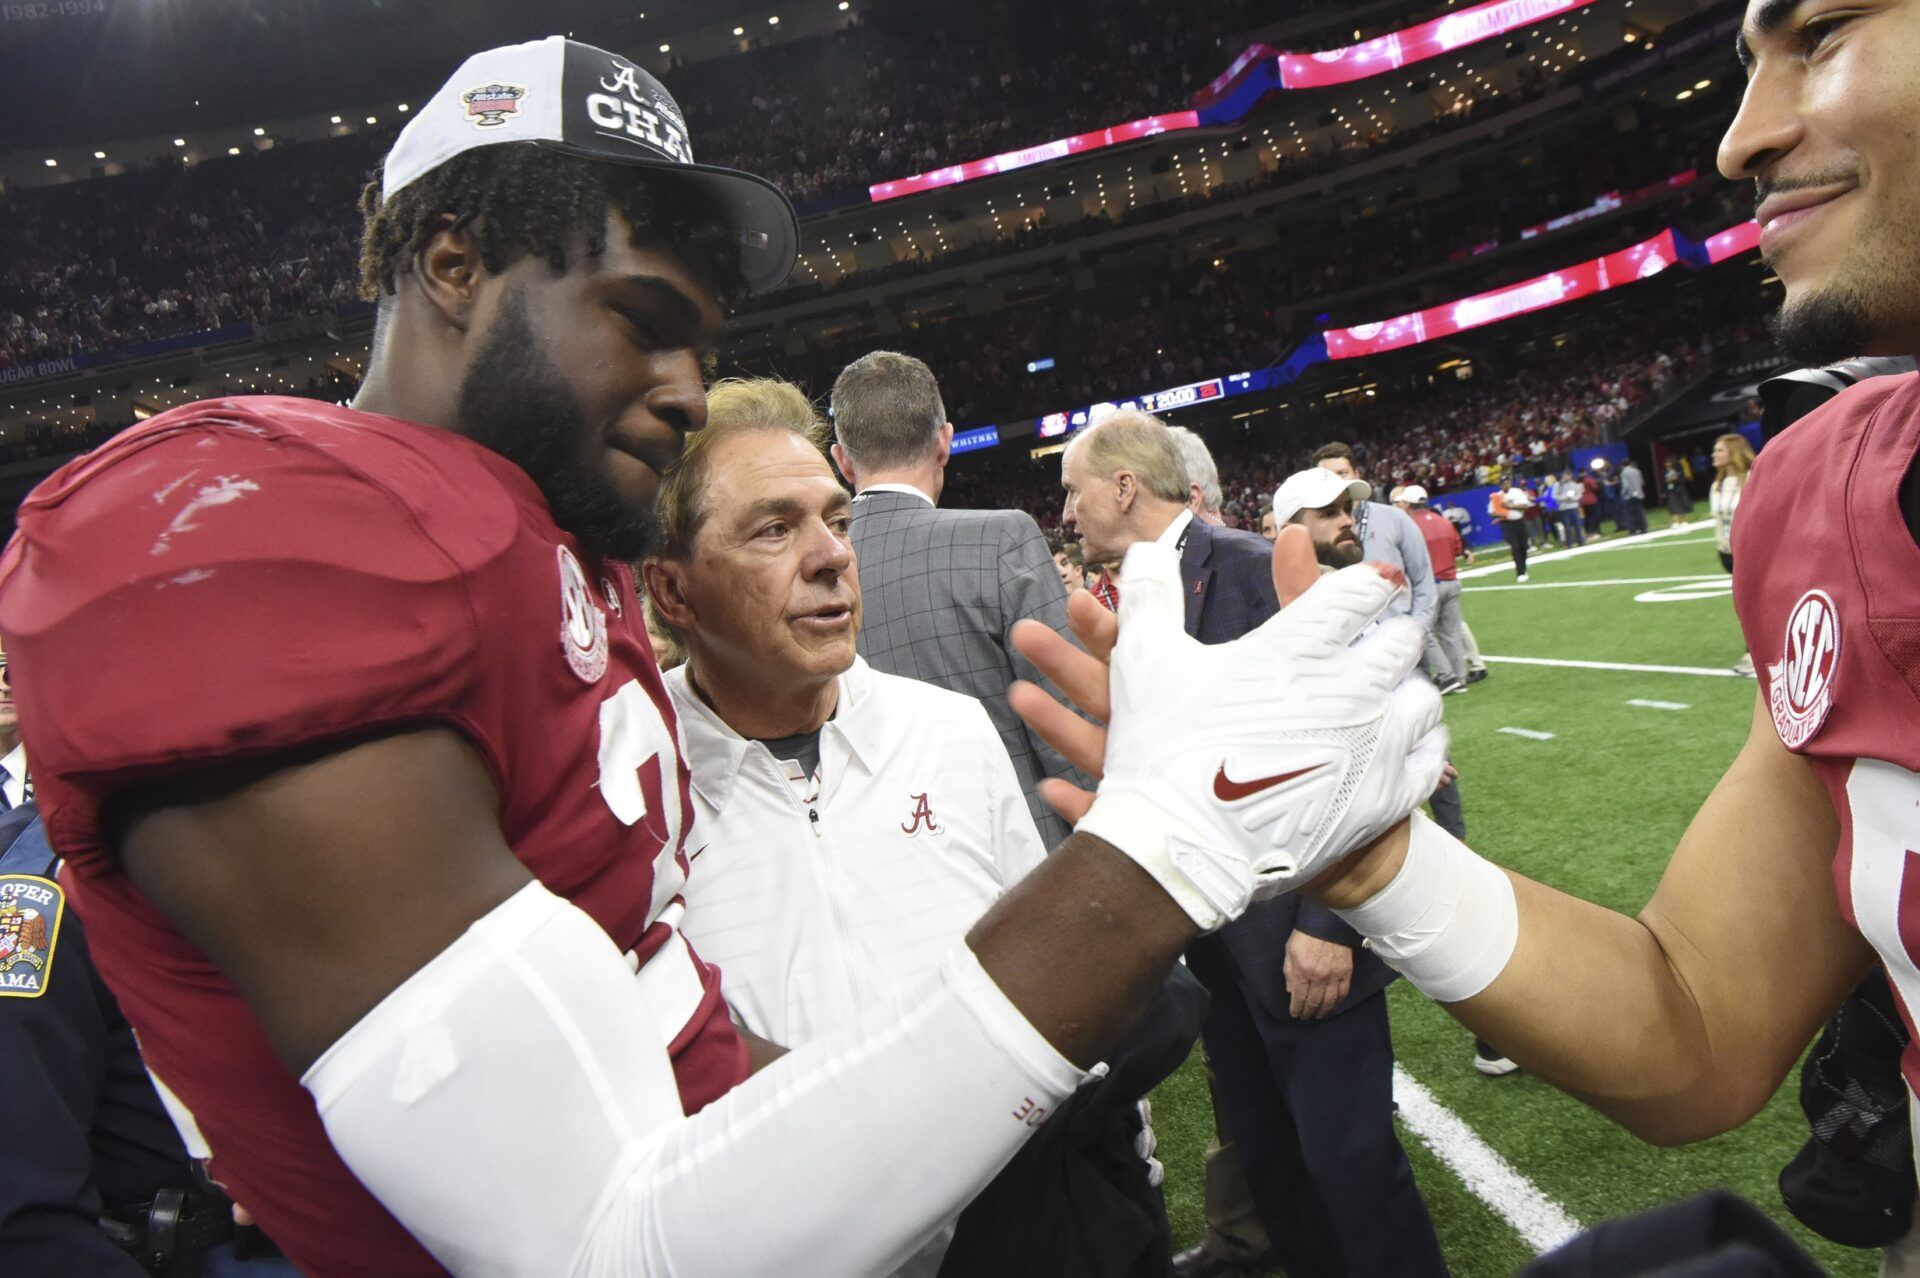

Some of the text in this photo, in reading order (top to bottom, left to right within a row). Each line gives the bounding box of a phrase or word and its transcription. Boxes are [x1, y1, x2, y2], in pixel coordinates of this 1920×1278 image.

[471, 92, 514, 102] Allstate
[600, 60, 644, 102] A
[587, 93, 694, 164] CHA
[39, 358, 78, 376] BOWL
[951, 432, 998, 448] WHITNEY
[1787, 600, 1833, 707] SEC
[1772, 688, 1816, 744] GRADUATE
[901, 792, 938, 834] A
